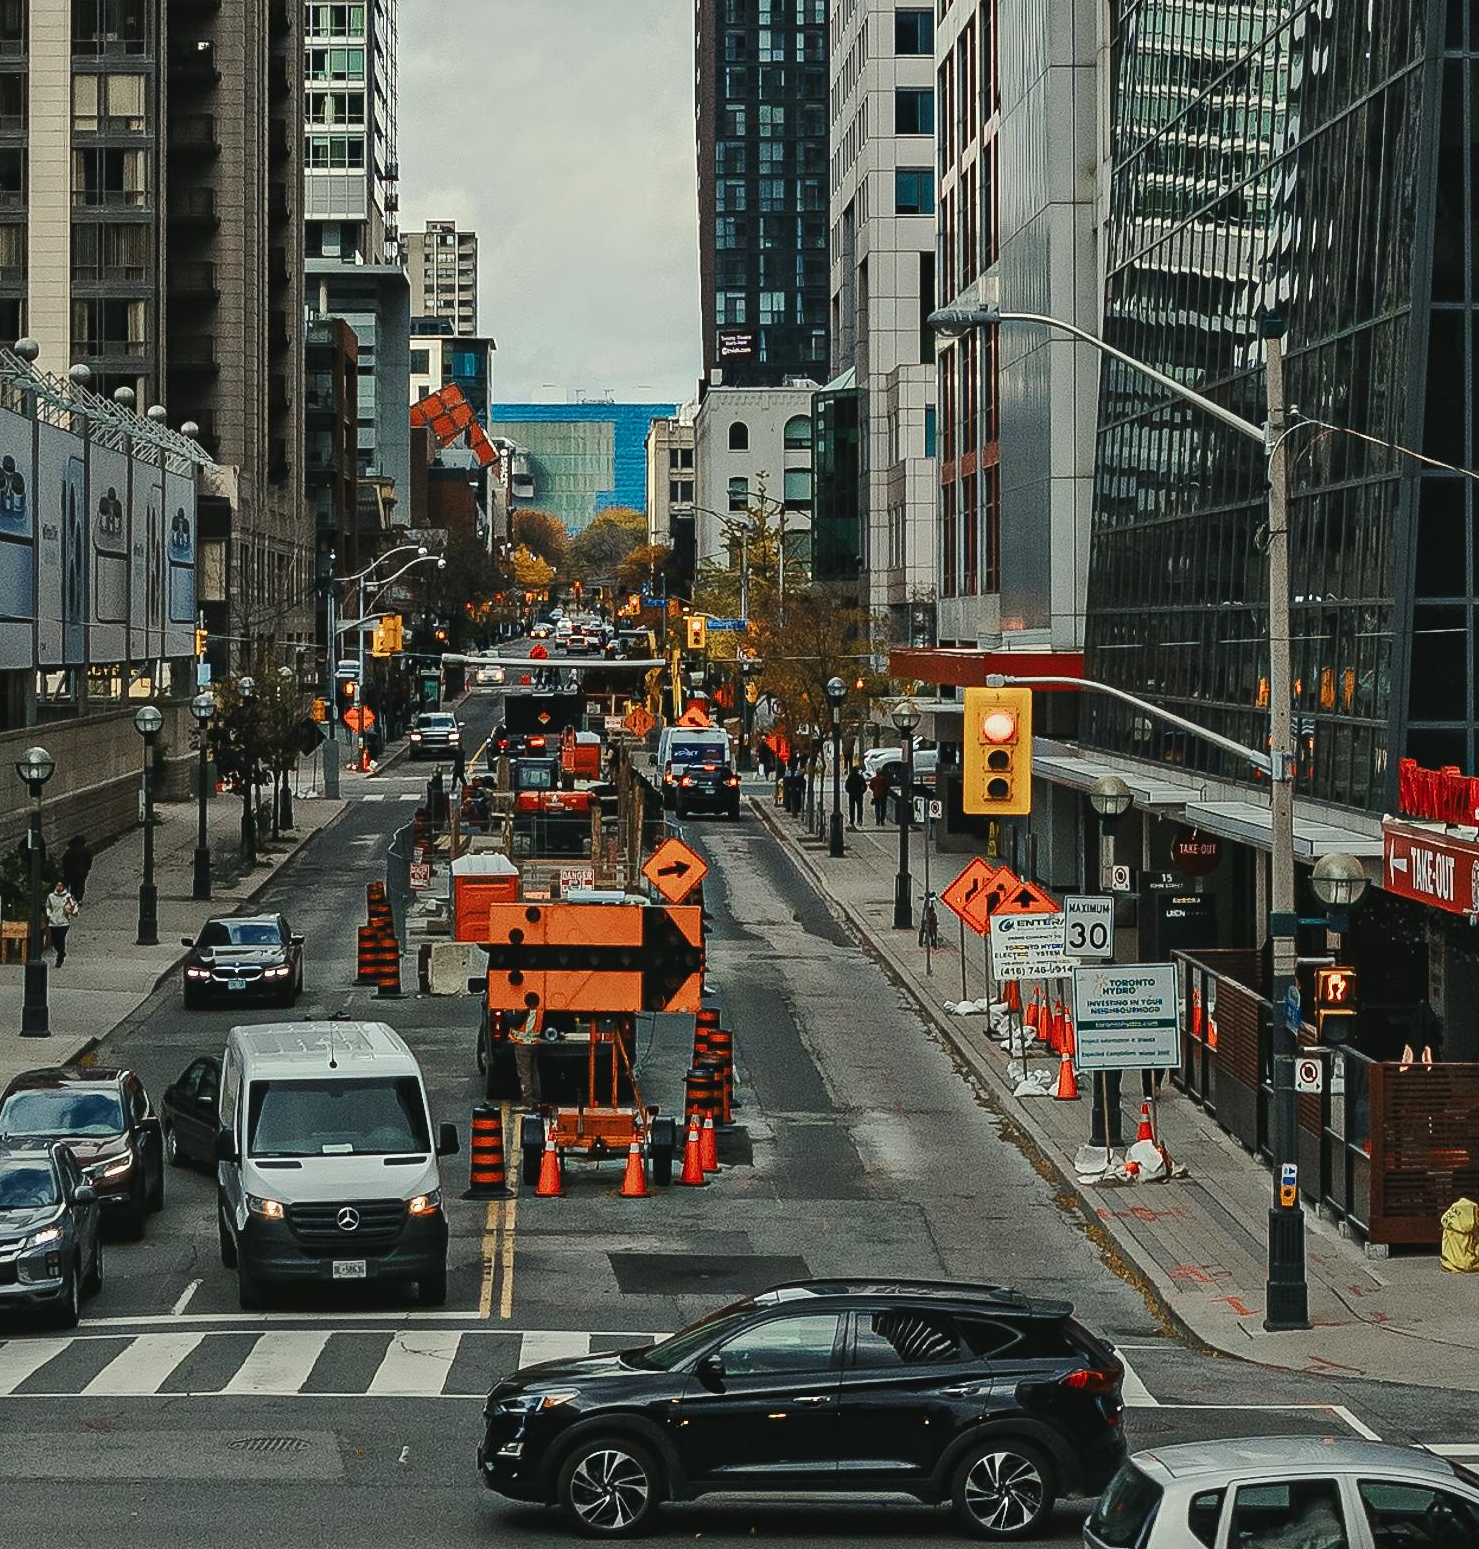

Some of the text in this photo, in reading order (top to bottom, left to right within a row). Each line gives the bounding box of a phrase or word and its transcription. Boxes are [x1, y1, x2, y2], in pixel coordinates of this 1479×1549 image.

[1179, 844, 1216, 854] TAKE-OUT
[1162, 873, 1172, 882] 15
[1411, 846, 1455, 901] TAKE-OUT
[1069, 903, 1110, 913] MAXIMUM
[1069, 922, 1108, 949] 30
[1109, 979, 1155, 987] TORONTO
[1102, 987, 1136, 995] HYDRO
